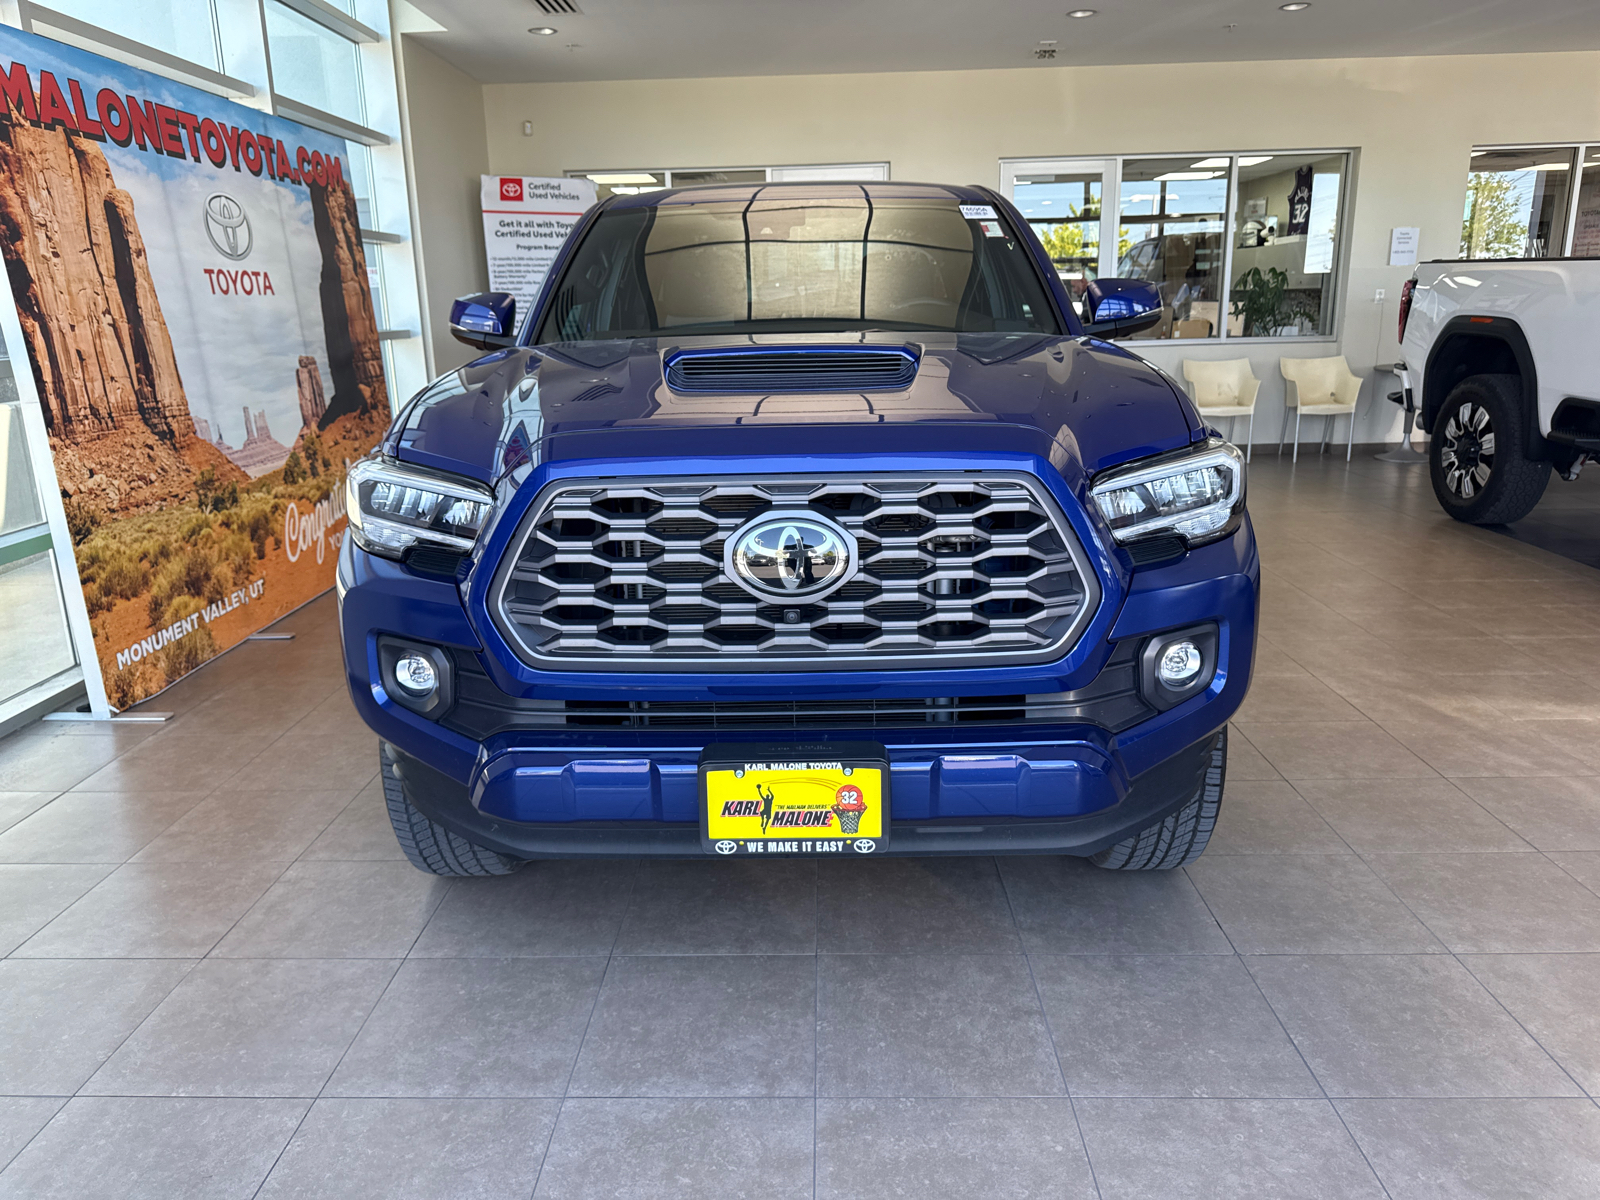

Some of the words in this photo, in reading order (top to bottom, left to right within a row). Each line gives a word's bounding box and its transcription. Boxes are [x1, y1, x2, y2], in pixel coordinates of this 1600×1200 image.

[528, 182, 561, 191] Certified
[528, 191, 549, 200] Used
[550, 192, 580, 201] Vehicles
[1292, 203, 1309, 224] 32
[499, 220, 515, 228] Get
[516, 220, 522, 228] it
[523, 220, 535, 228] all
[536, 221, 554, 229] with
[556, 221, 575, 232] Toyo
[494, 230, 532, 238] Certified
[532, 230, 554, 239] Used
[516, 244, 544, 252] Program
[203, 268, 275, 296] TOYOTA
[285, 477, 348, 565] Congratu
[116, 612, 200, 671] MONUMENT
[201, 586, 250, 624] VALLEY,
[249, 578, 265, 599] UT
[744, 763, 770, 771] KARL
[808, 762, 843, 770] TOYOTA
[841, 791, 858, 804] 32
[720, 800, 763, 818] KARL
[770, 811, 834, 828] MALONE
[746, 841, 764, 852] WE
[767, 841, 799, 852] MAKE
[802, 841, 813, 852] IT
[815, 841, 844, 852] EASY
